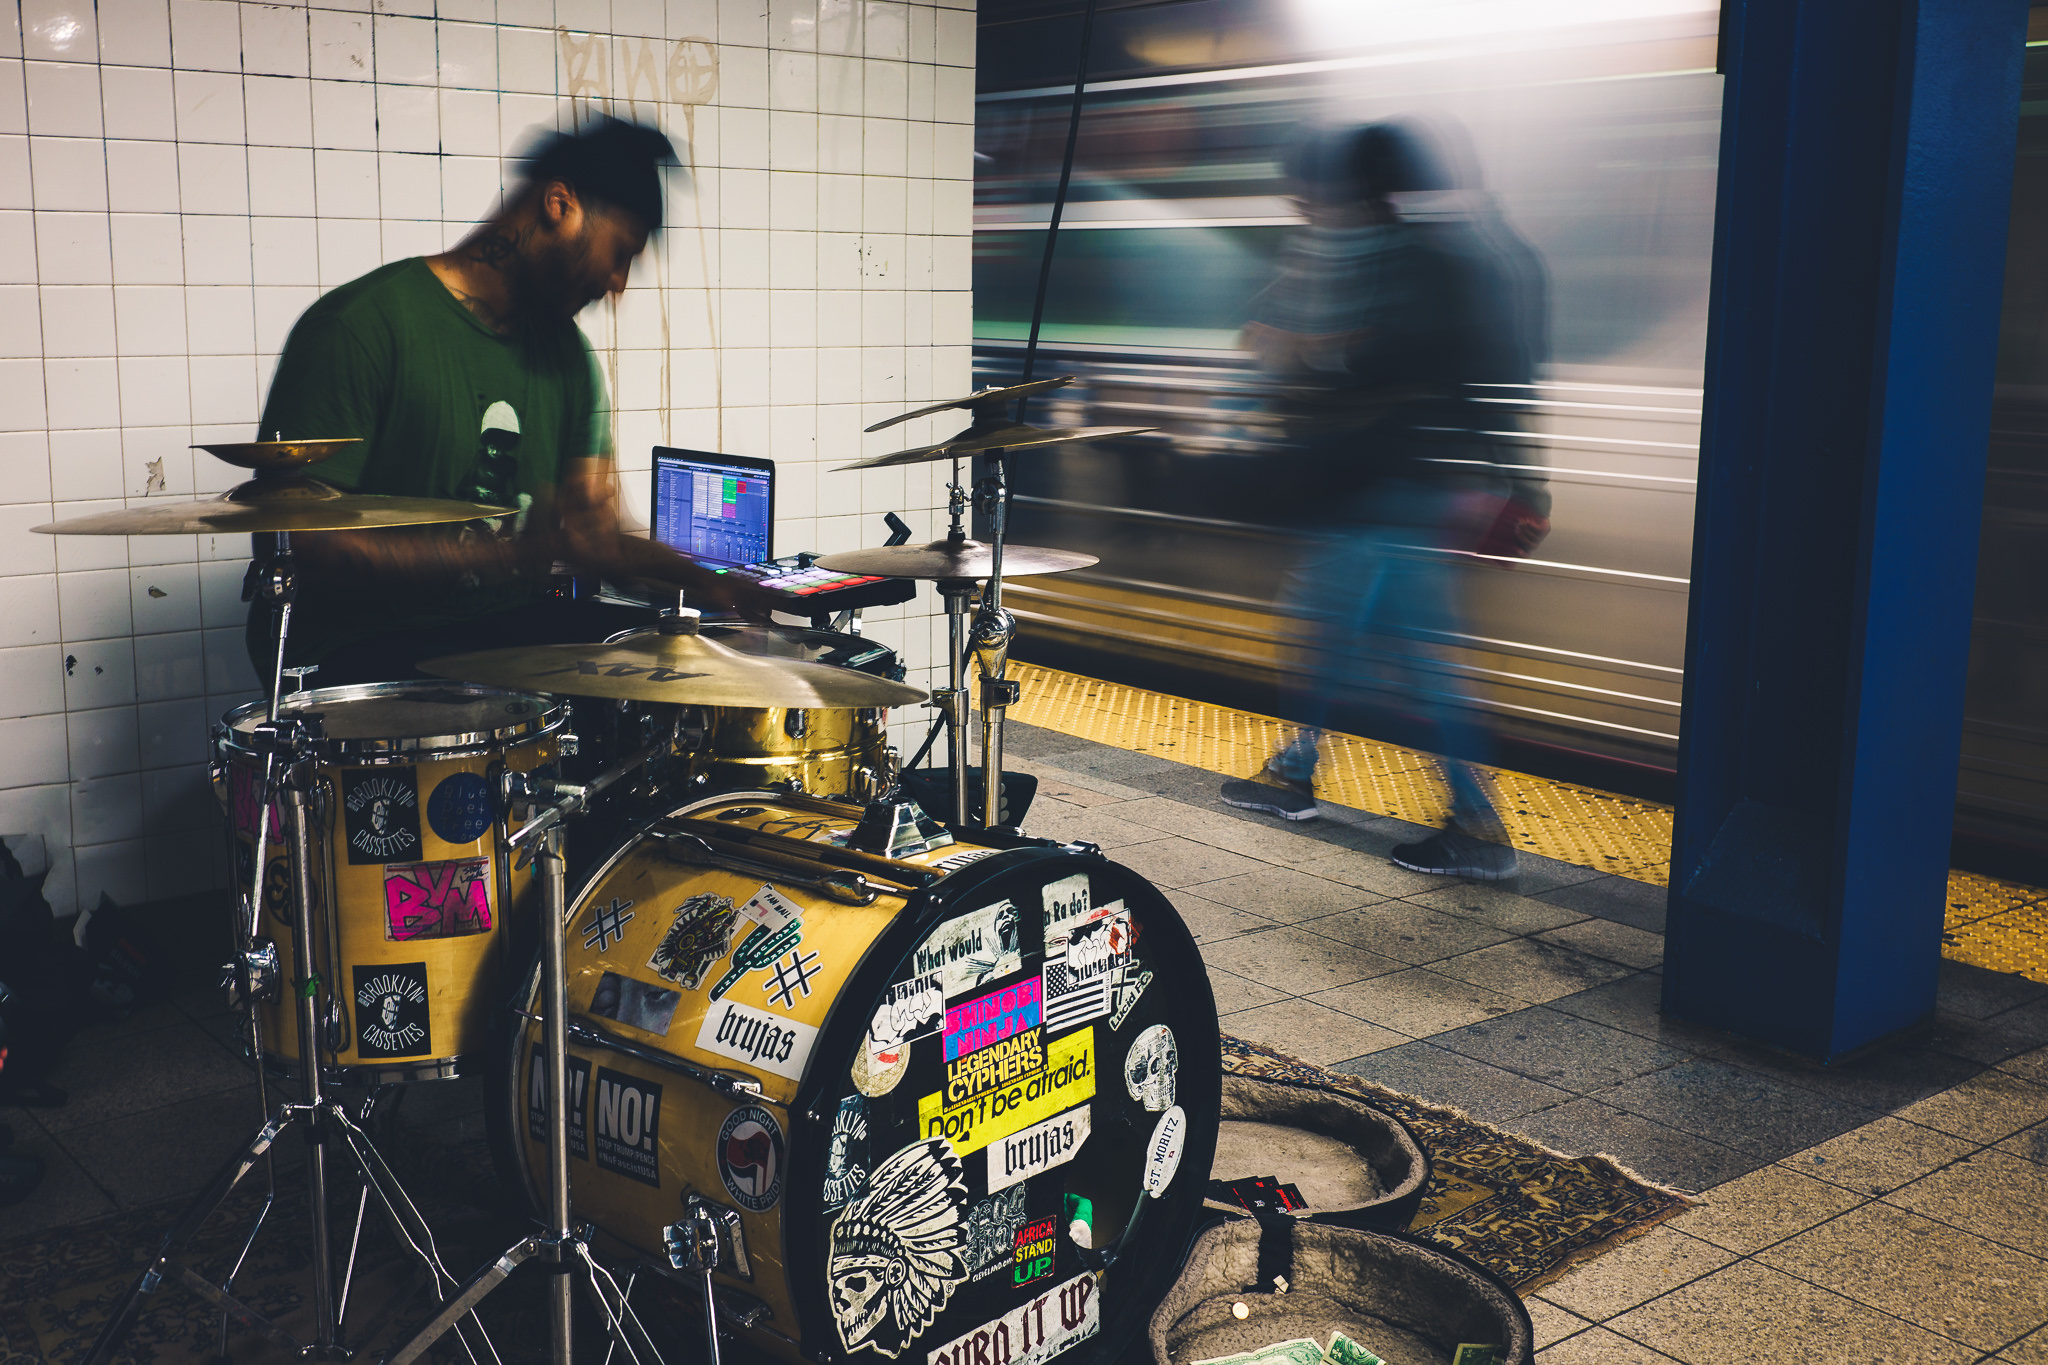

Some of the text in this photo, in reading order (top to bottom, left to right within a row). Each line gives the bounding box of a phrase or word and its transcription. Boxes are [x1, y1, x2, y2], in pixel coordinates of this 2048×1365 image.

[347, 778, 415, 809] BROOKLYN
[352, 827, 416, 856] CASSETTES
[763, 893, 792, 919] FAN MAIL
[1069, 888, 1088, 917] do?
[717, 921, 798, 993] CACTUS PLANT
[738, 931, 762, 958] FLEA
[755, 937, 798, 967] MARKET
[916, 927, 983, 975] What would
[358, 974, 425, 1004] BROOKLYN
[945, 980, 1040, 1037] SHINOBI
[1111, 993, 1137, 1028] Lucid
[362, 1022, 425, 1051] CASSETTES
[715, 1003, 797, 1064] brujas
[957, 1011, 1030, 1058] NINJA
[947, 1027, 1042, 1082] LEGENDARY
[947, 1045, 1044, 1103] CYPHERS
[598, 1079, 655, 1152] NO!
[991, 1086, 1023, 1119] be
[721, 1108, 778, 1141] GOOD NIGHT
[1153, 1117, 1179, 1165] MORITZ
[597, 1137, 612, 1151] STOP
[1004, 1120, 1075, 1177] brujas
[727, 1173, 781, 1209] WHITE PRIDE
[1149, 1168, 1162, 1187] ST.
[1014, 1220, 1054, 1249] AFRICA
[1015, 1238, 1053, 1263] STAND
[1014, 1256, 1052, 1284] UP
[1021, 1294, 1050, 1355] IT
[1058, 1274, 1095, 1332] UP
